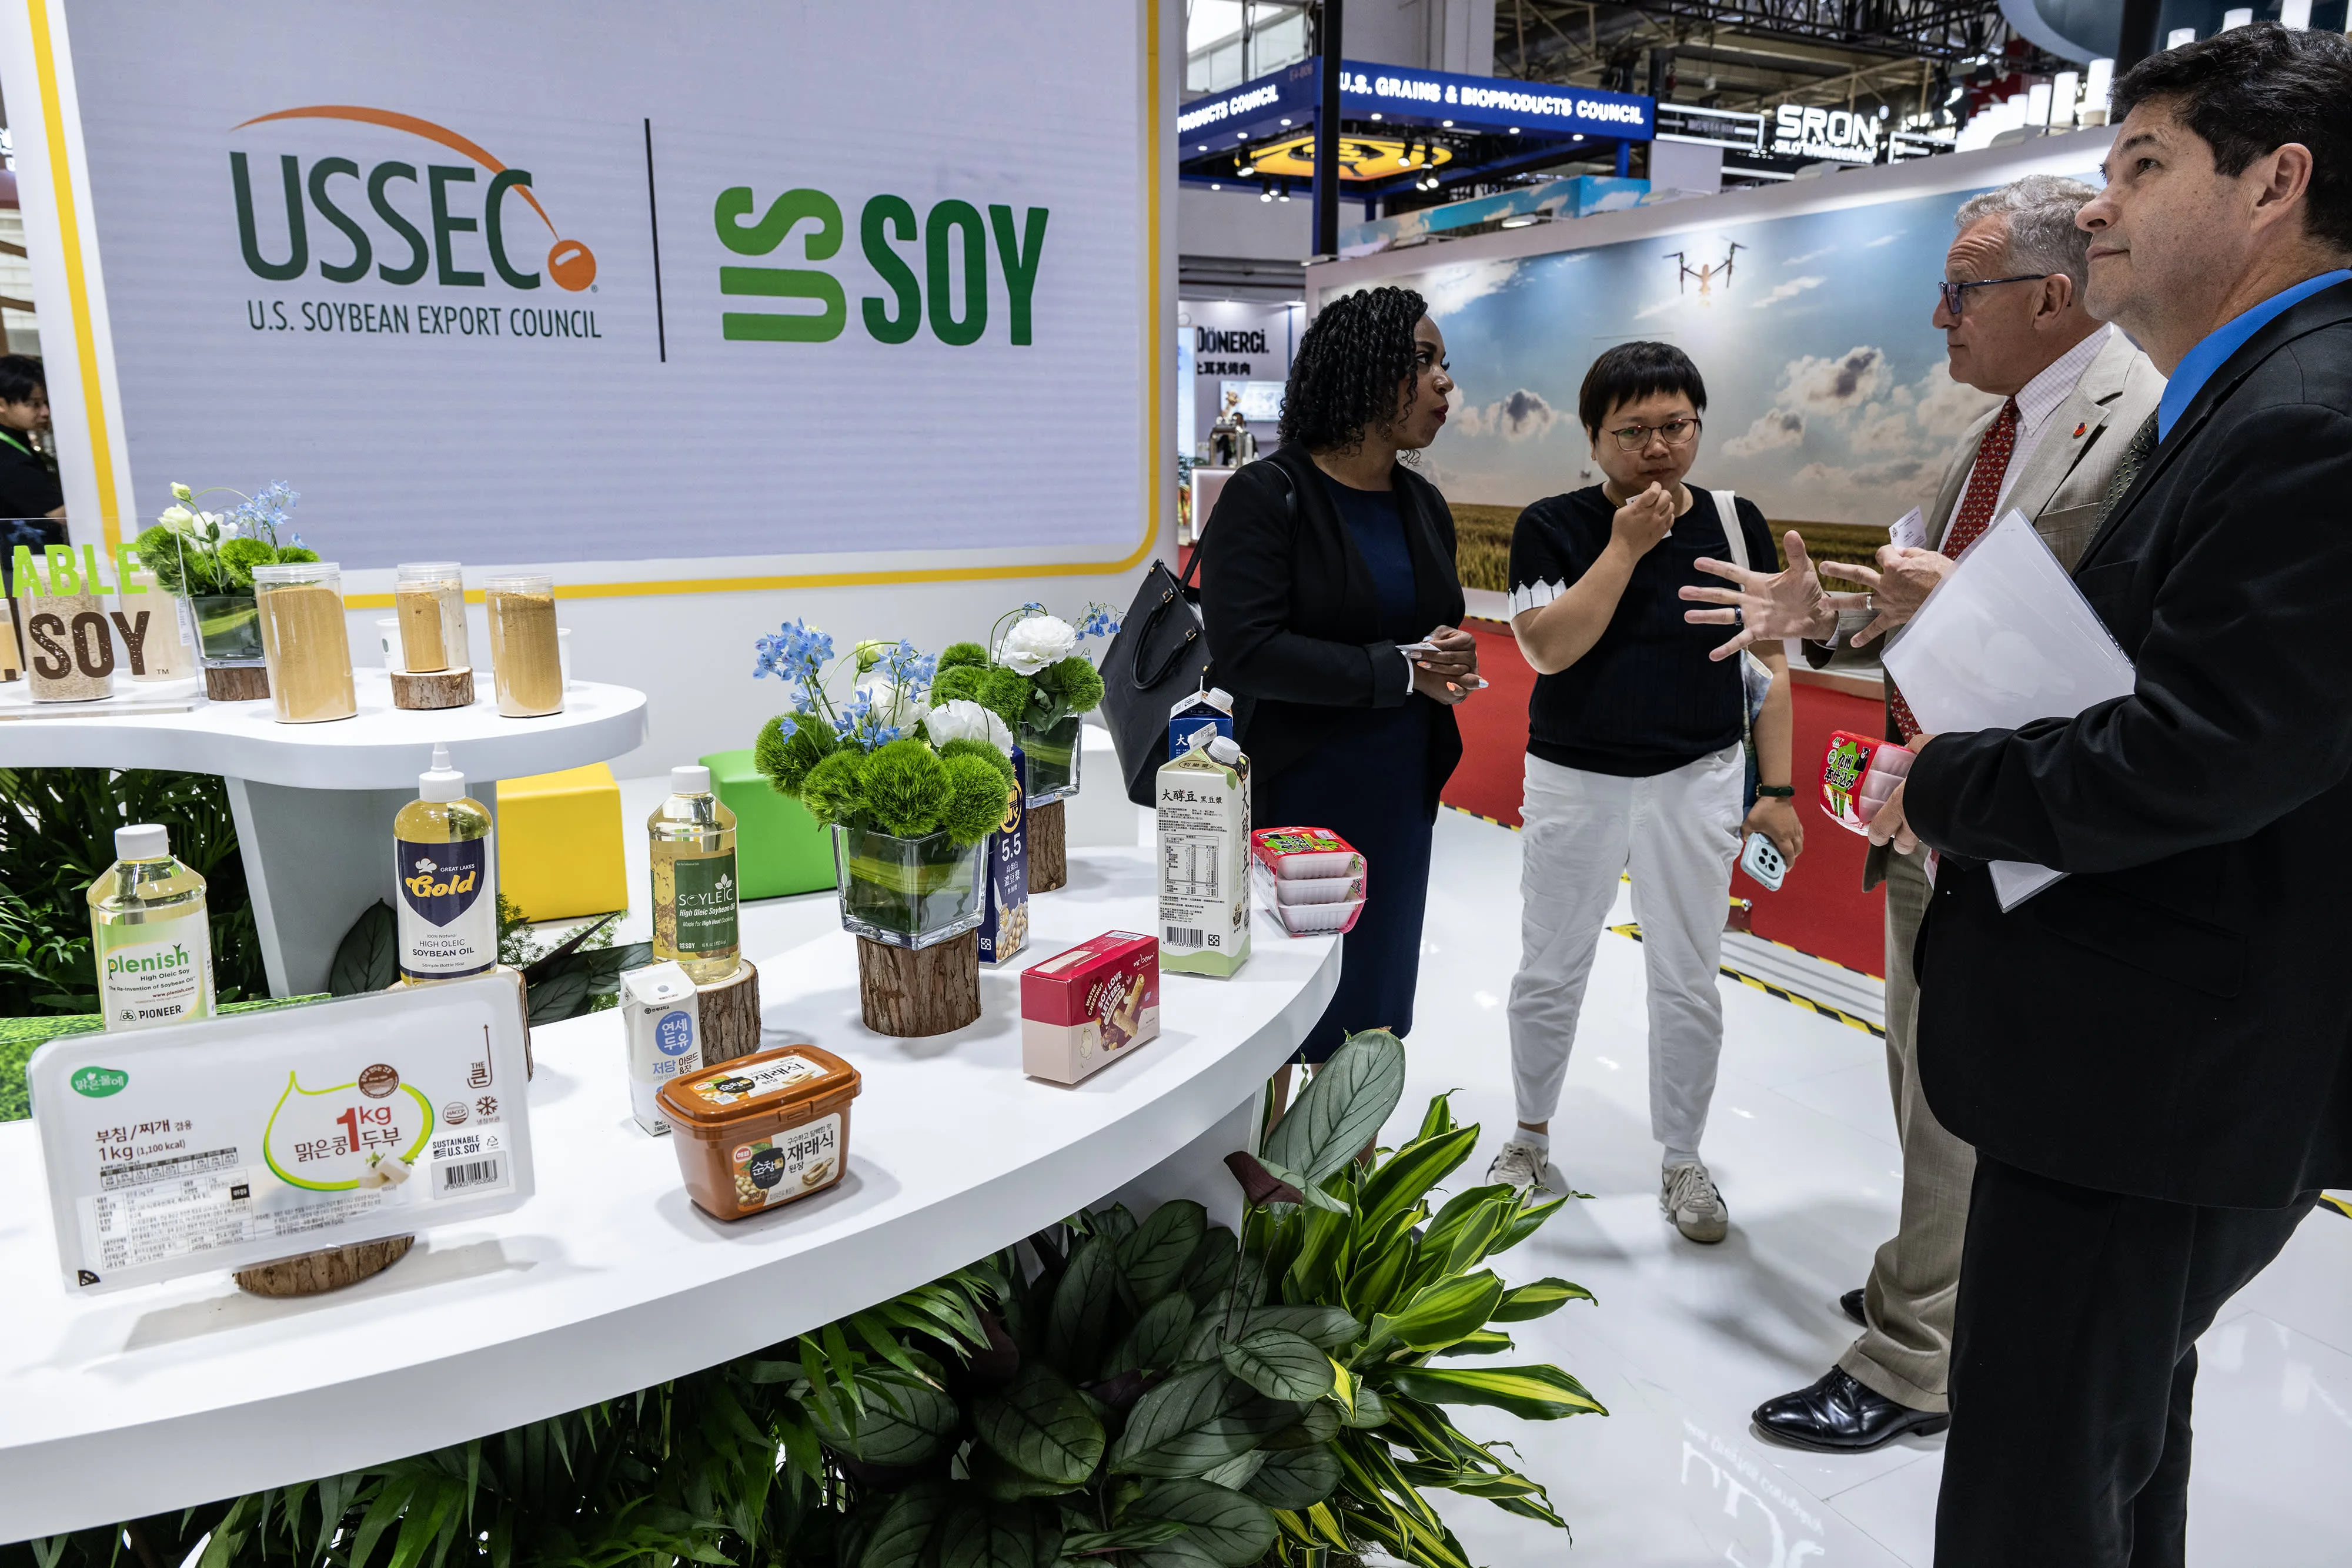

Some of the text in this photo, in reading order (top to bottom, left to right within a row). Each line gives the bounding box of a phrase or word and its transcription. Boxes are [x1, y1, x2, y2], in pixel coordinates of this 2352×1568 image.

[1230, 84, 1279, 115] COUNCIL
[1339, 71, 1645, 125] U.S. GRAINS & BIOPRODUCTS COUNCIL
[1775, 104, 1878, 147] SRON
[229, 151, 541, 290] USSEC
[714, 186, 847, 343] US
[860, 194, 1049, 346] SOY
[248, 300, 602, 338] U.S. SOYBEAN EXPORT COUNCIL
[0, 543, 148, 598] ABLE
[29, 611, 151, 680] SOY
[1837, 752, 1854, 771] 九州
[1824, 766, 1855, 790] 本仕込み
[1161, 788, 1198, 803] 大醇豆
[1001, 832, 1022, 862] 5.5
[405, 871, 476, 898] Gold
[679, 909, 693, 918] High
[693, 907, 708, 917] Oleic
[709, 905, 730, 915] Soybean
[413, 949, 456, 957] SOYBEAN
[441, 939, 465, 947] OLEIC
[108, 943, 188, 980] plenish
[178, 968, 190, 977] Soy
[152, 986, 195, 998] www.plenish.com
[161, 979, 185, 989] Soybean
[1098, 987, 1108, 1009] SOY
[1107, 971, 1122, 990] LOVE
[1085, 984, 1098, 1007] WATER
[1088, 982, 1103, 1016] CHESTNUT
[662, 1018, 688, 1037] 연세
[664, 1033, 689, 1050] 두유
[652, 1052, 699, 1075] 저당 아몬드
[751, 1062, 806, 1082] 재래식
[471, 1068, 487, 1085] 큰
[174, 1120, 193, 1132] 겸용
[336, 1105, 392, 1153] 1kg
[787, 1133, 809, 1145] 구수하고
[810, 1126, 826, 1137] 담백한
[99, 1139, 185, 1161] 1kg (1,100 kcal)
[295, 1127, 402, 1162] 맑은콩 두부
[432, 1135, 480, 1149] SUSTAINABLE
[447, 1143, 480, 1156] U.S. SOY
[787, 1130, 834, 1162] 재래식
[737, 1150, 750, 1158] 해표
[752, 1161, 776, 1176] 순창
[789, 1162, 804, 1174] 된장
